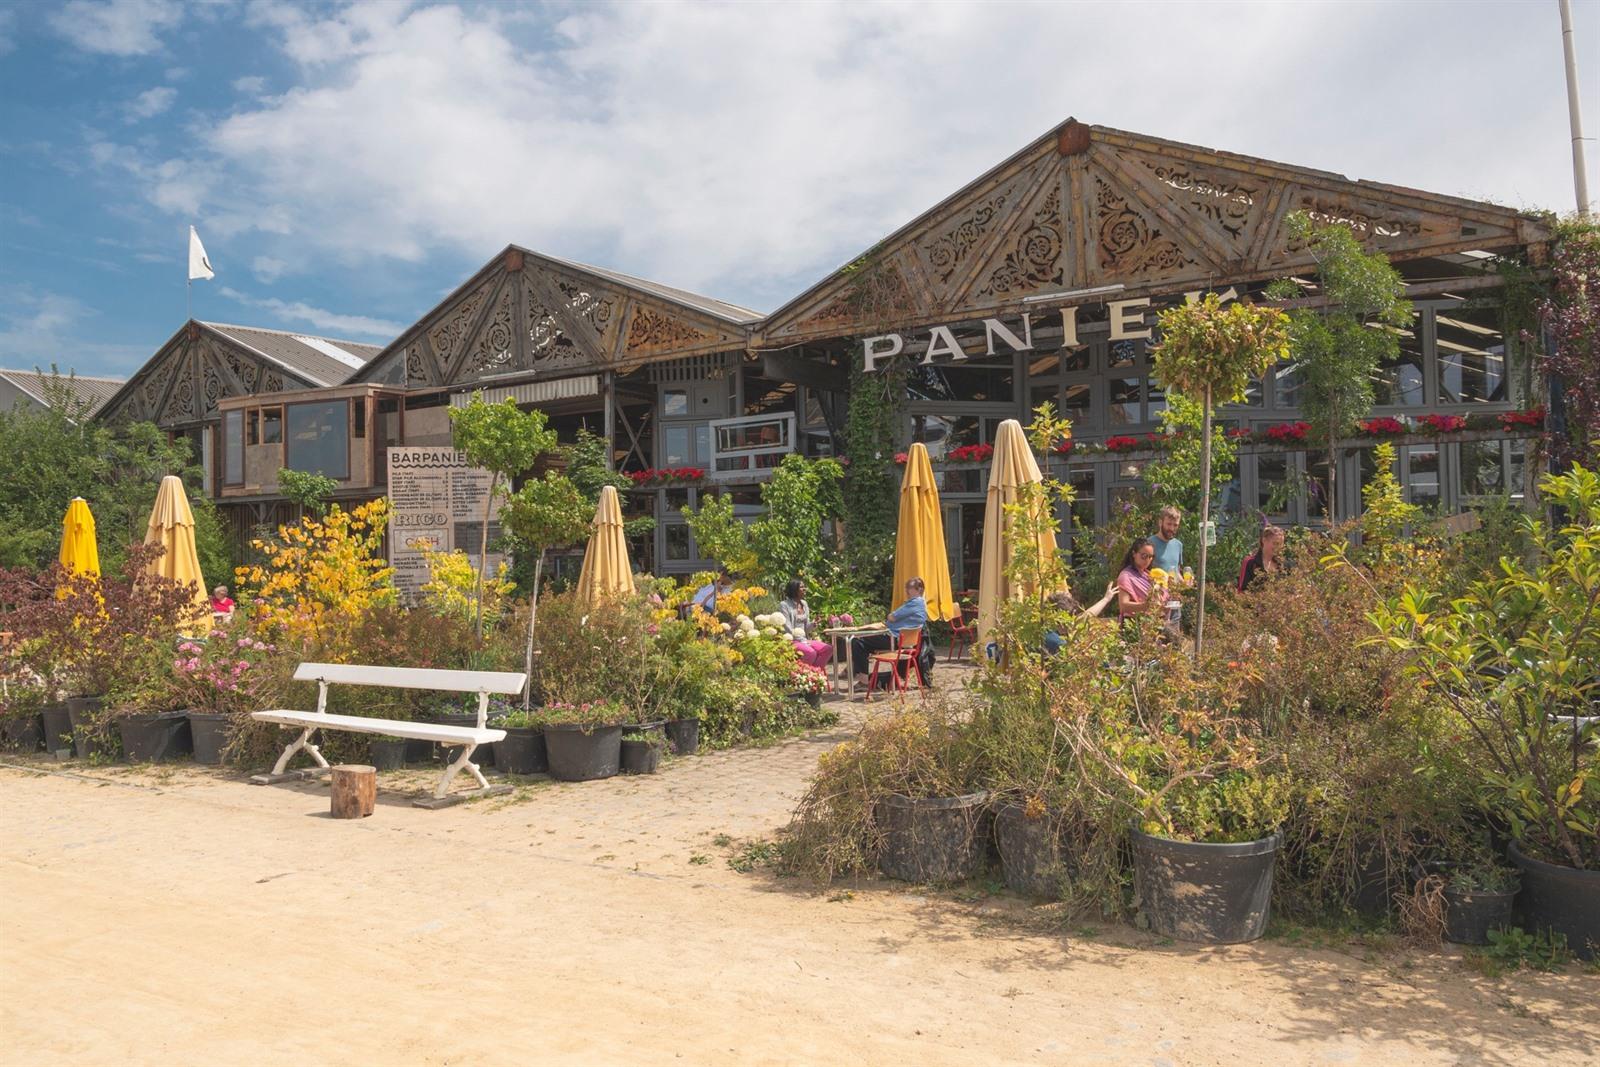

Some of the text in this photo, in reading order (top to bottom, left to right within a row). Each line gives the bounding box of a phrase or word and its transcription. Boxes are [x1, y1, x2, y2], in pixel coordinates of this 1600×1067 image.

[862, 287, 1238, 373] PANIE
[392, 453, 469, 463] BARPANIE
[394, 513, 448, 526] RICO
